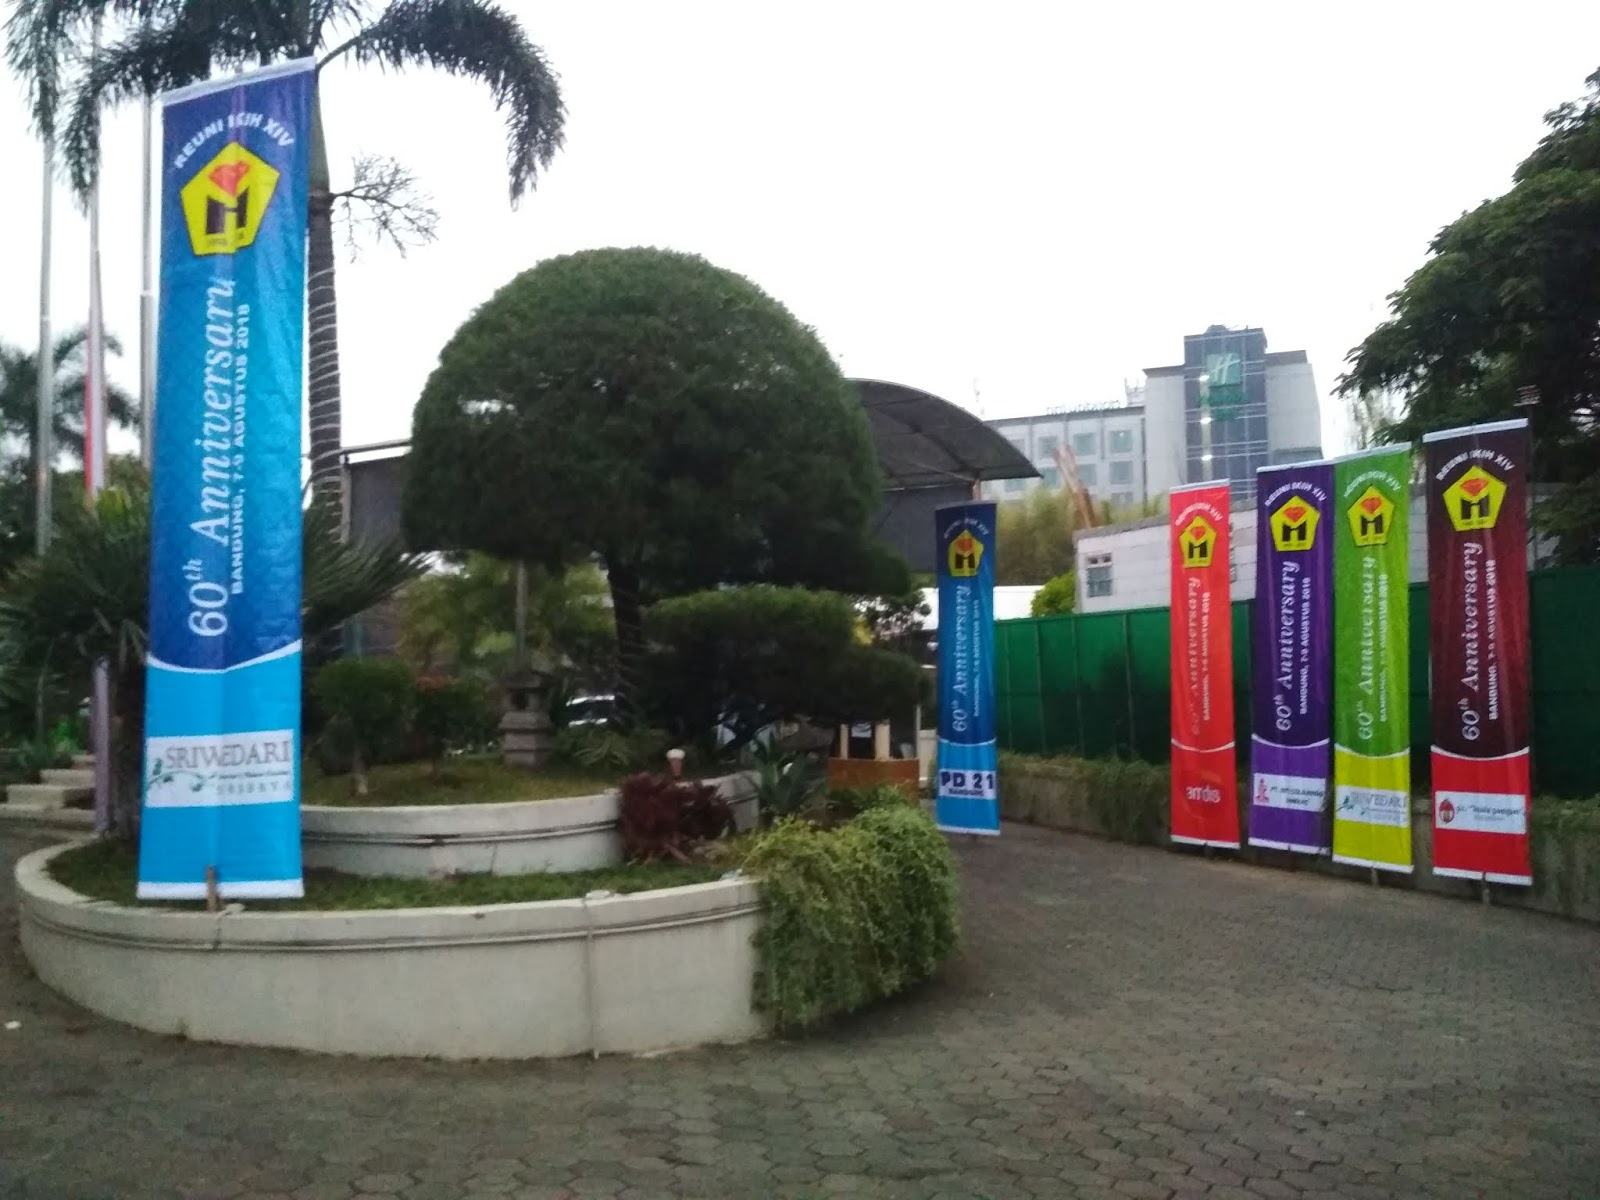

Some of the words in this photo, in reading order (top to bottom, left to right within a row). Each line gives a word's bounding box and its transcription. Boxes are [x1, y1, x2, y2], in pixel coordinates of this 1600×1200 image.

[174, 118, 224, 168] REUNI
[263, 118, 295, 146] XIV
[236, 303, 250, 350] 2018
[233, 354, 248, 447] AGUSTUS
[1493, 453, 1516, 472] XIV
[1312, 486, 1327, 502] XIV
[1277, 561, 1300, 690] Anniversary
[1300, 601, 1311, 647] AGUSTUS
[1460, 542, 1483, 692] Anniversary
[1486, 587, 1497, 641] AGUSTUS
[953, 585, 972, 696] Anniversary
[165, 741, 290, 769] SRIWEDARI
[941, 771, 966, 788] PD
[972, 773, 993, 790] 21
